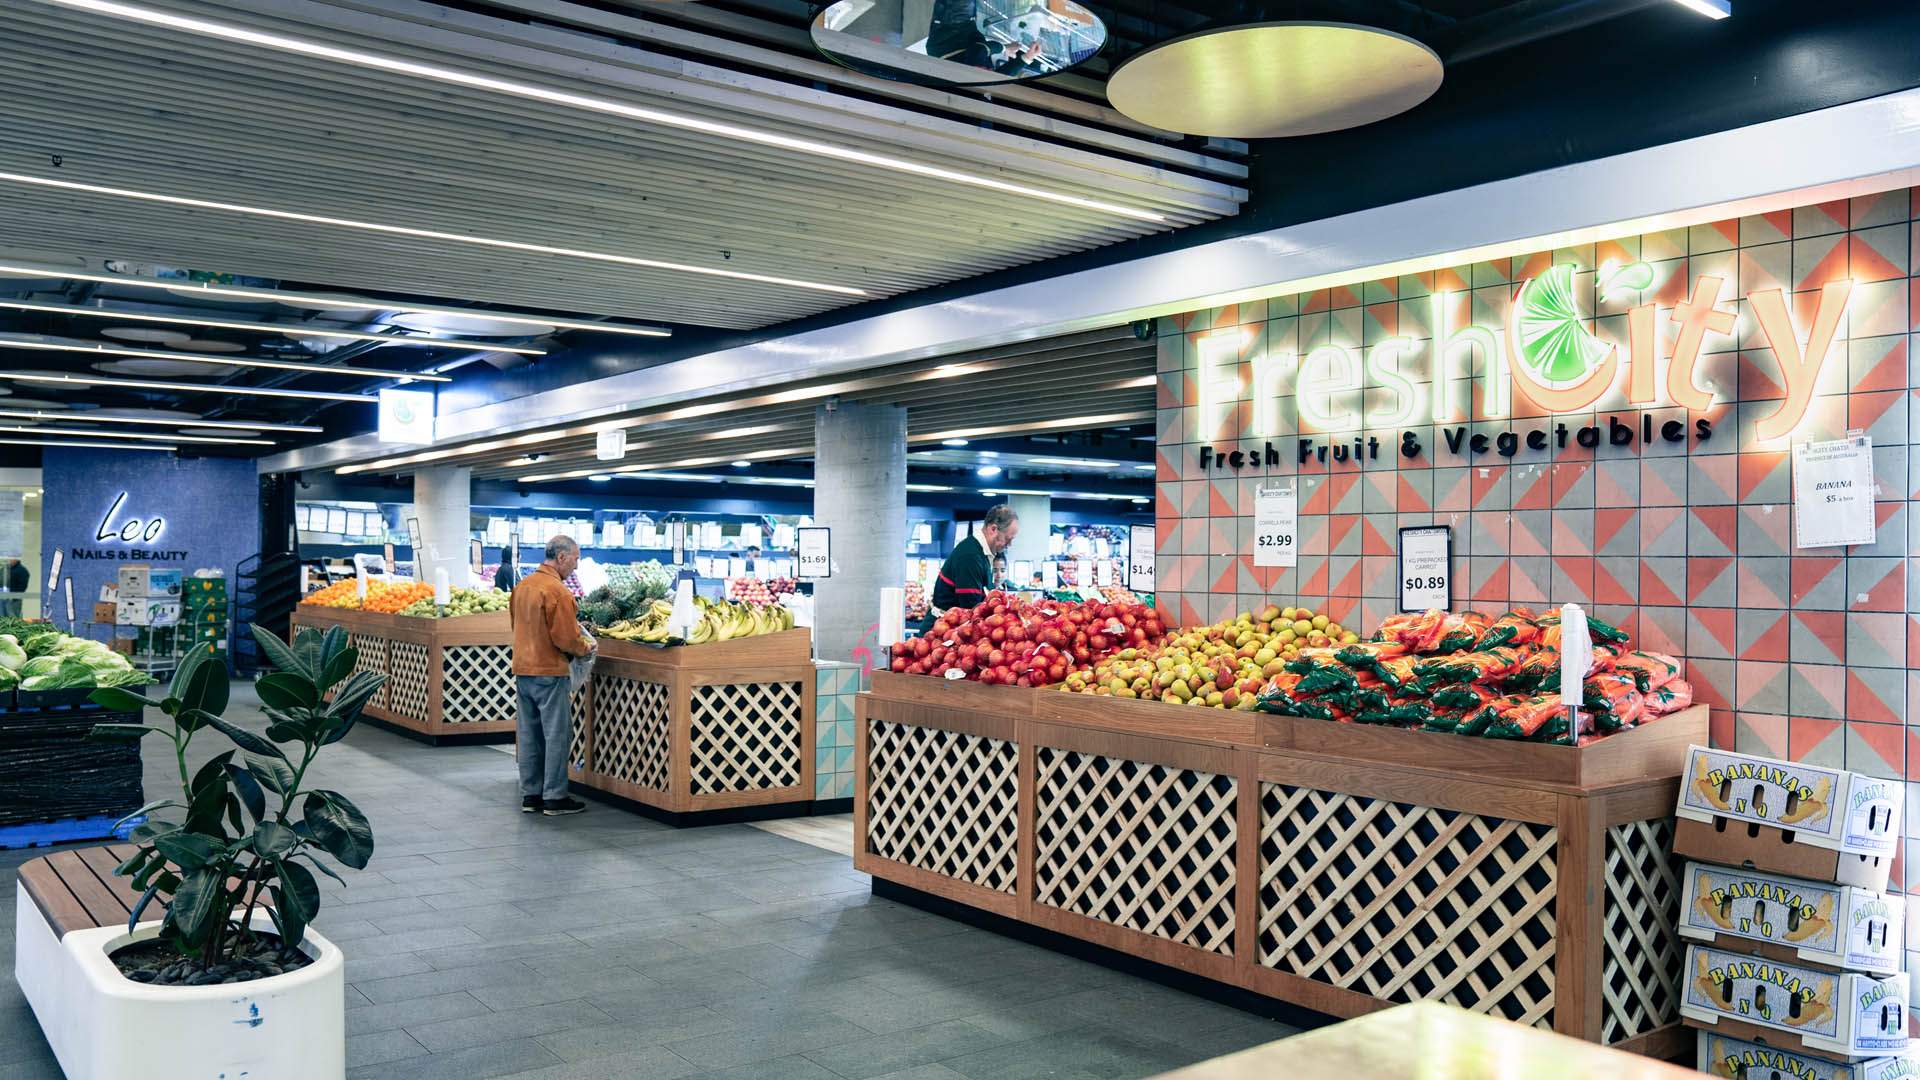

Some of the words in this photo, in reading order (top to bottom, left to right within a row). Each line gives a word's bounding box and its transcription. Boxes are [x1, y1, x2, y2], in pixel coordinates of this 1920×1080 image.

[1200, 441, 1279, 469] Fresh
[1299, 437, 1379, 464] Fruit
[1401, 431, 1421, 458] &
[1443, 413, 1712, 457] Vegetables
[1815, 480, 1852, 490] BANANA
[1825, 495, 1836, 503] $5
[96, 491, 162, 542] Leo
[1258, 534, 1292, 548] $2.99
[72, 548, 115, 560] NAILS
[118, 550, 128, 560] &
[131, 548, 188, 560] BEAUTY
[801, 555, 826, 563] $1.69
[1406, 577, 1445, 591] $0.89
[1707, 763, 1813, 801] BANANAS
[1711, 881, 1817, 920] BANANAS
[1708, 962, 1816, 1003] BANANAS
[1725, 1050, 1818, 1080] BANANA
